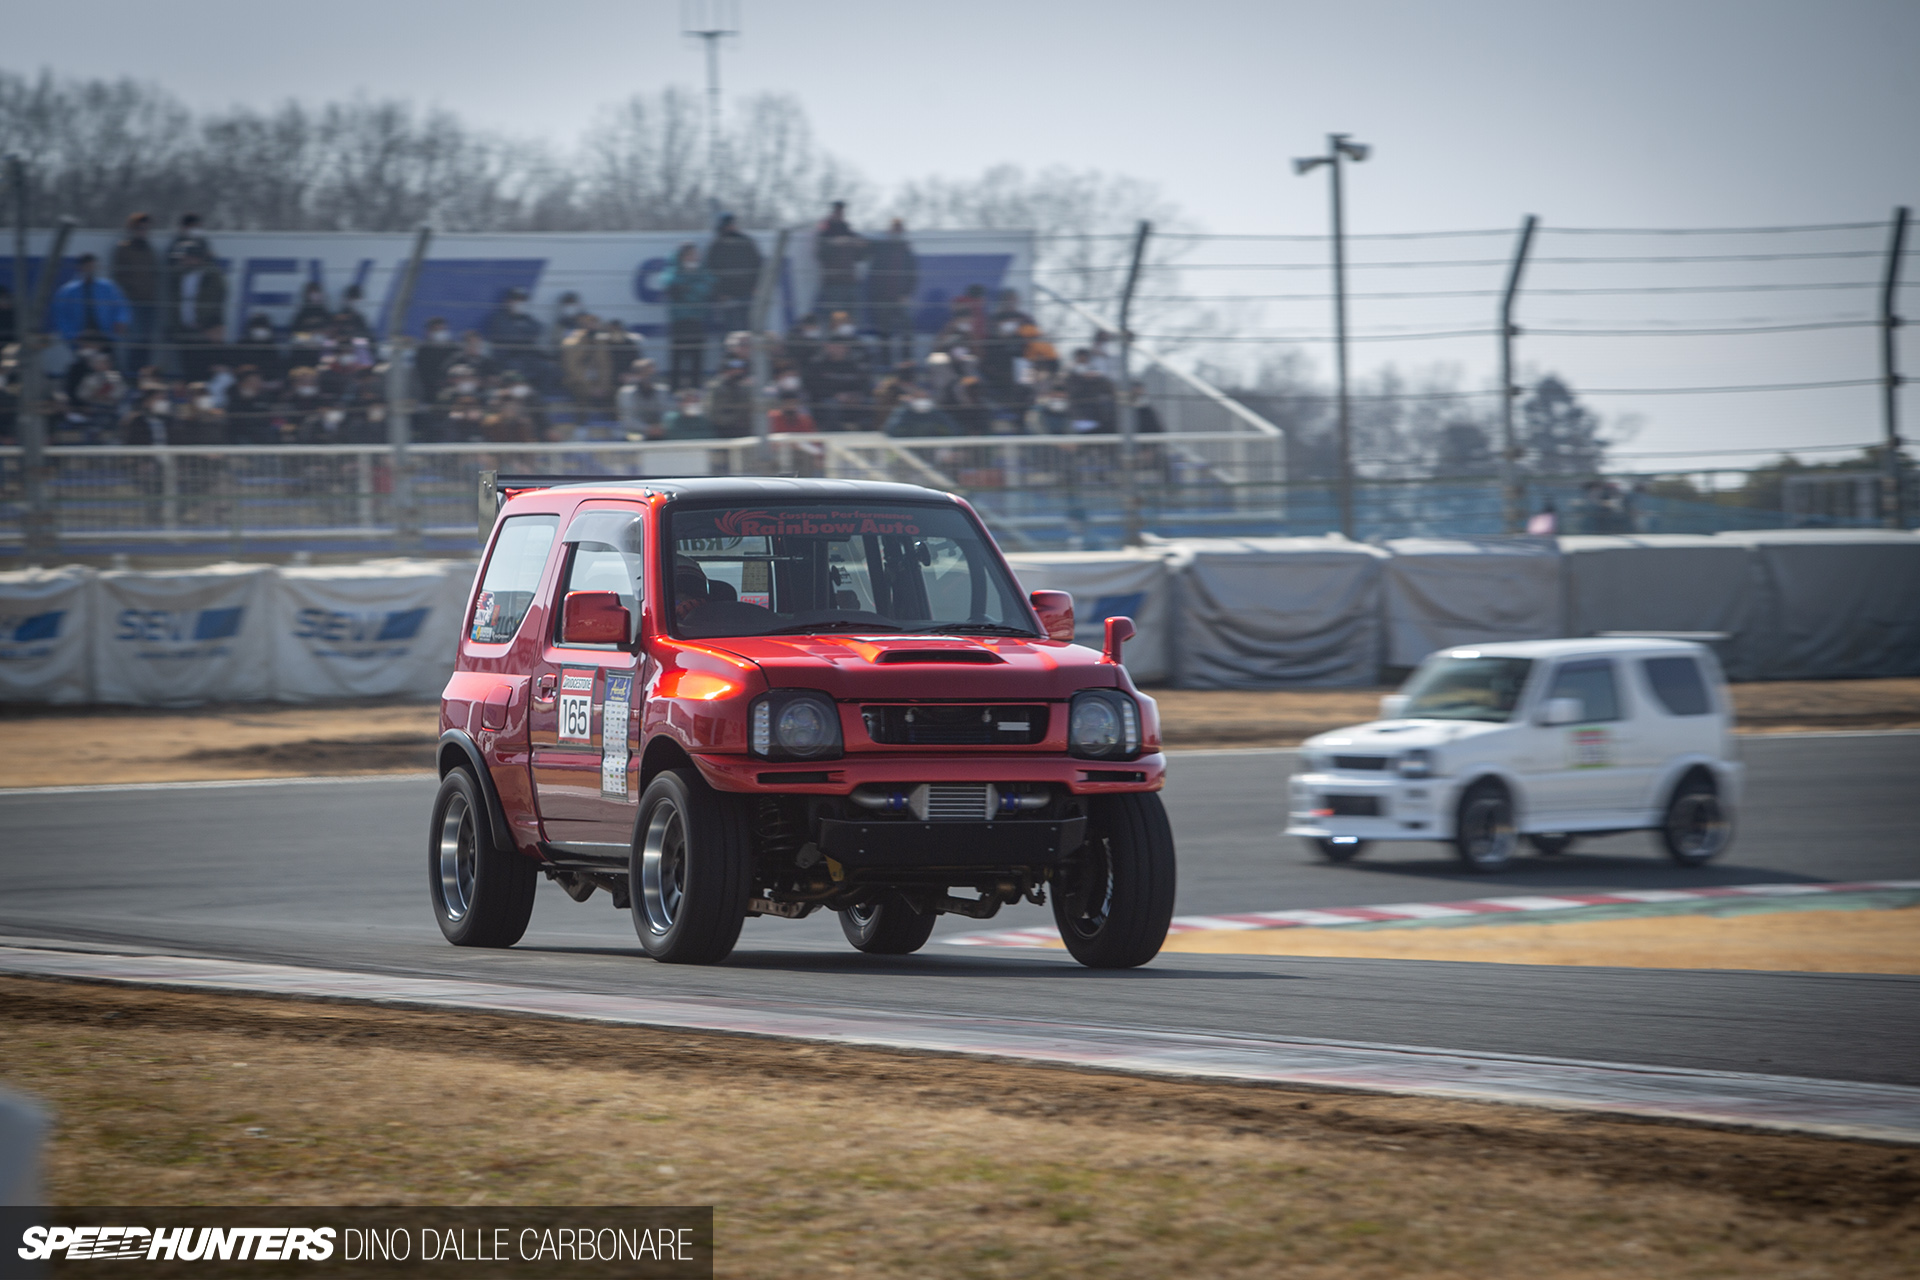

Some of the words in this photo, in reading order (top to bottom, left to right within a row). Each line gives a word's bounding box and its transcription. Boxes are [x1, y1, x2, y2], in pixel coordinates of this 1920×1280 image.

[779, 512, 827, 520] Custom
[831, 511, 914, 520] Performance
[741, 520, 855, 536] Rainbow
[859, 519, 920, 535] Auto
[563, 698, 588, 735] 165
